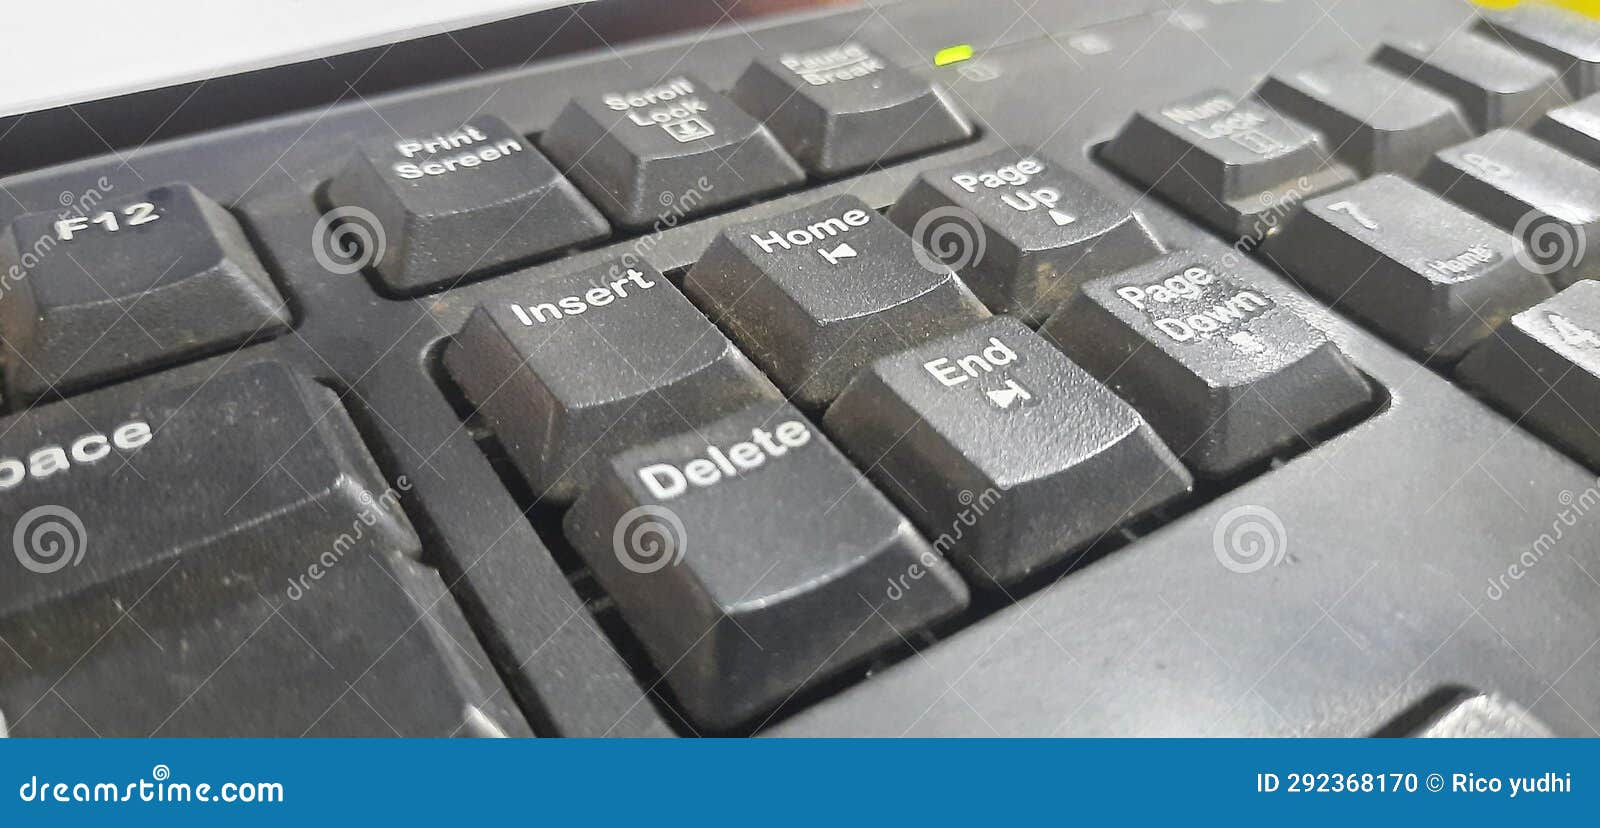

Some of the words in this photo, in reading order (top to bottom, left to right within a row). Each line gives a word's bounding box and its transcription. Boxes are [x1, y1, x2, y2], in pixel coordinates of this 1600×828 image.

[605, 76, 695, 112] Scroll
[628, 97, 708, 127] Lock
[395, 137, 523, 180] Screen
[399, 124, 487, 159] Print
[951, 157, 1044, 193] Page
[57, 202, 160, 240] F12
[1000, 185, 1061, 214] Up
[751, 206, 870, 254] Home
[511, 268, 655, 326] Insert
[1116, 263, 1208, 308] Page
[1152, 287, 1268, 341] Down
[923, 336, 1018, 387] End
[638, 420, 812, 499] Delete
